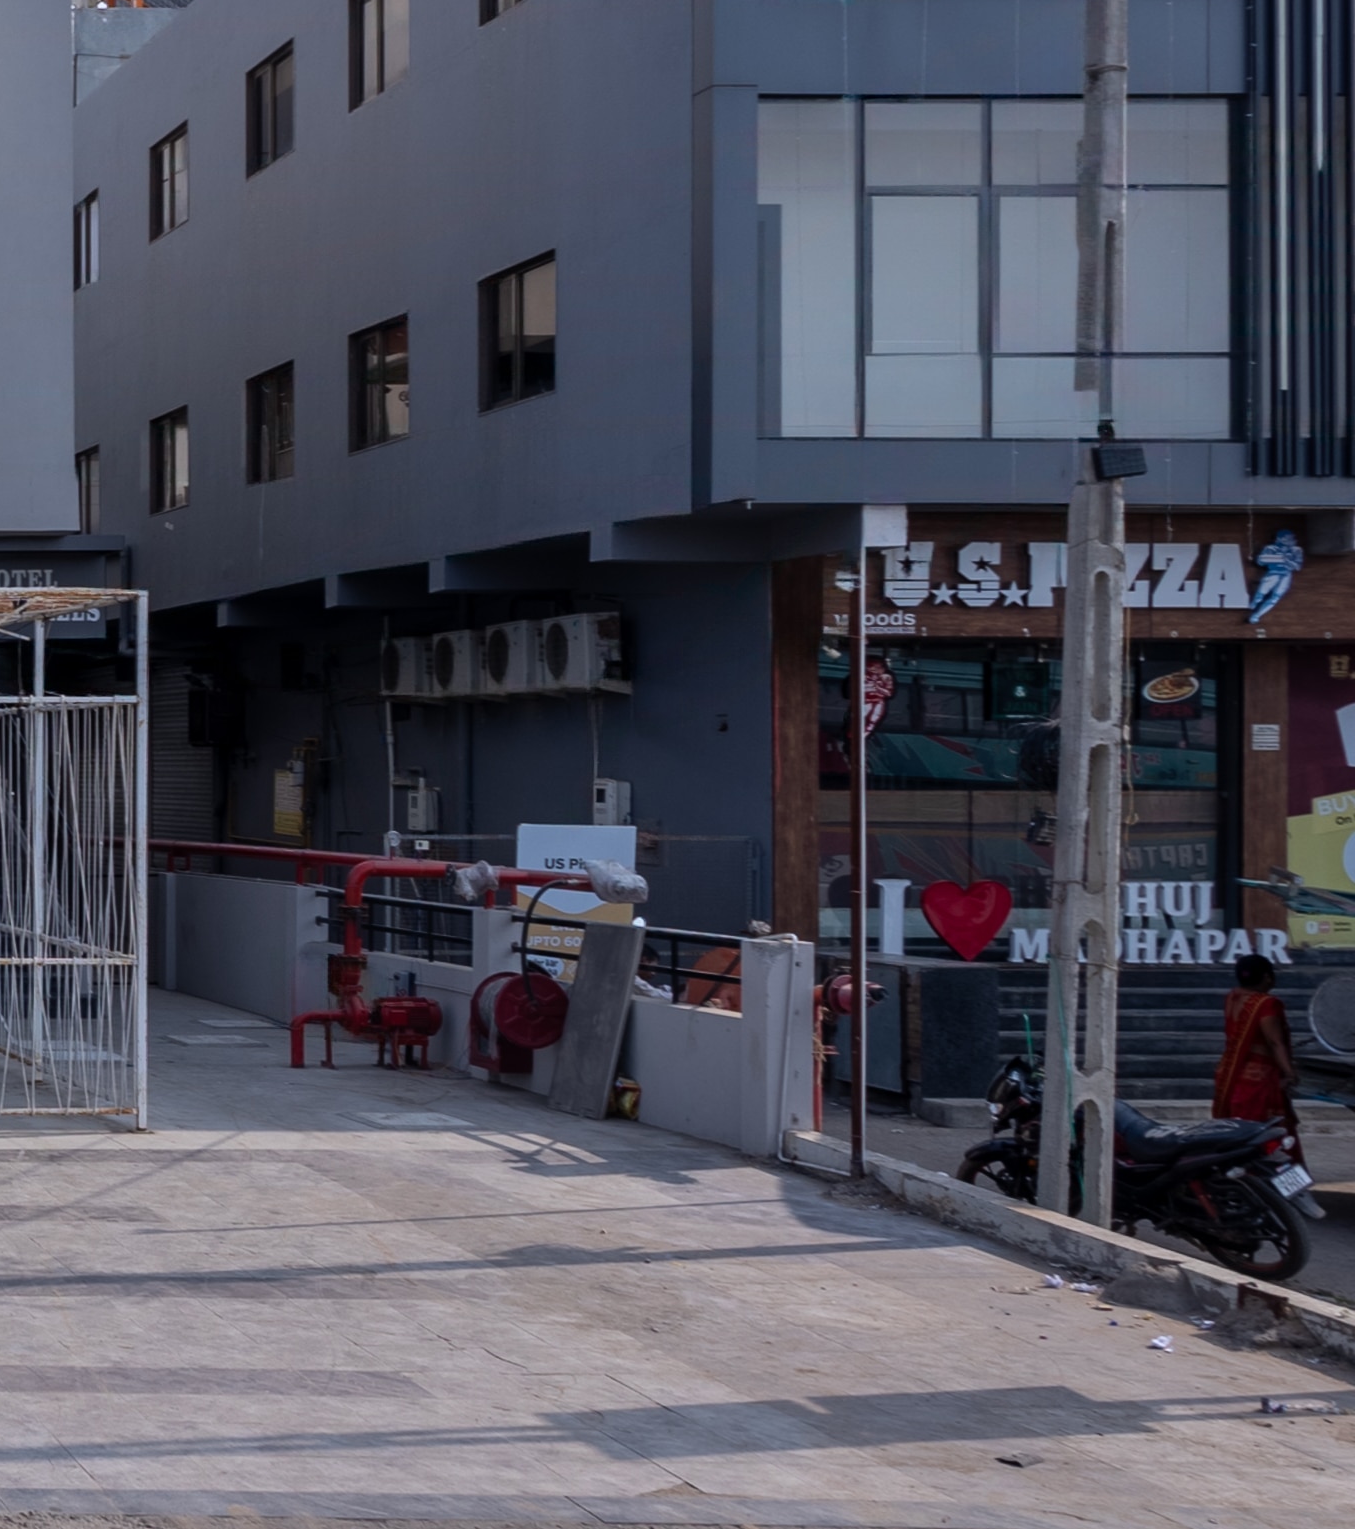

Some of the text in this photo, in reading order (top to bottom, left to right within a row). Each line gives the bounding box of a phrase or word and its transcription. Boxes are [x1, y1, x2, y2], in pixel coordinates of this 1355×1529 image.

[1027, 542, 1250, 607] PZZA
[545, 858, 565, 870] US
[873, 878, 912, 956] I
[1119, 881, 1214, 925] HUJ
[1008, 927, 1293, 964] MHAPAR
